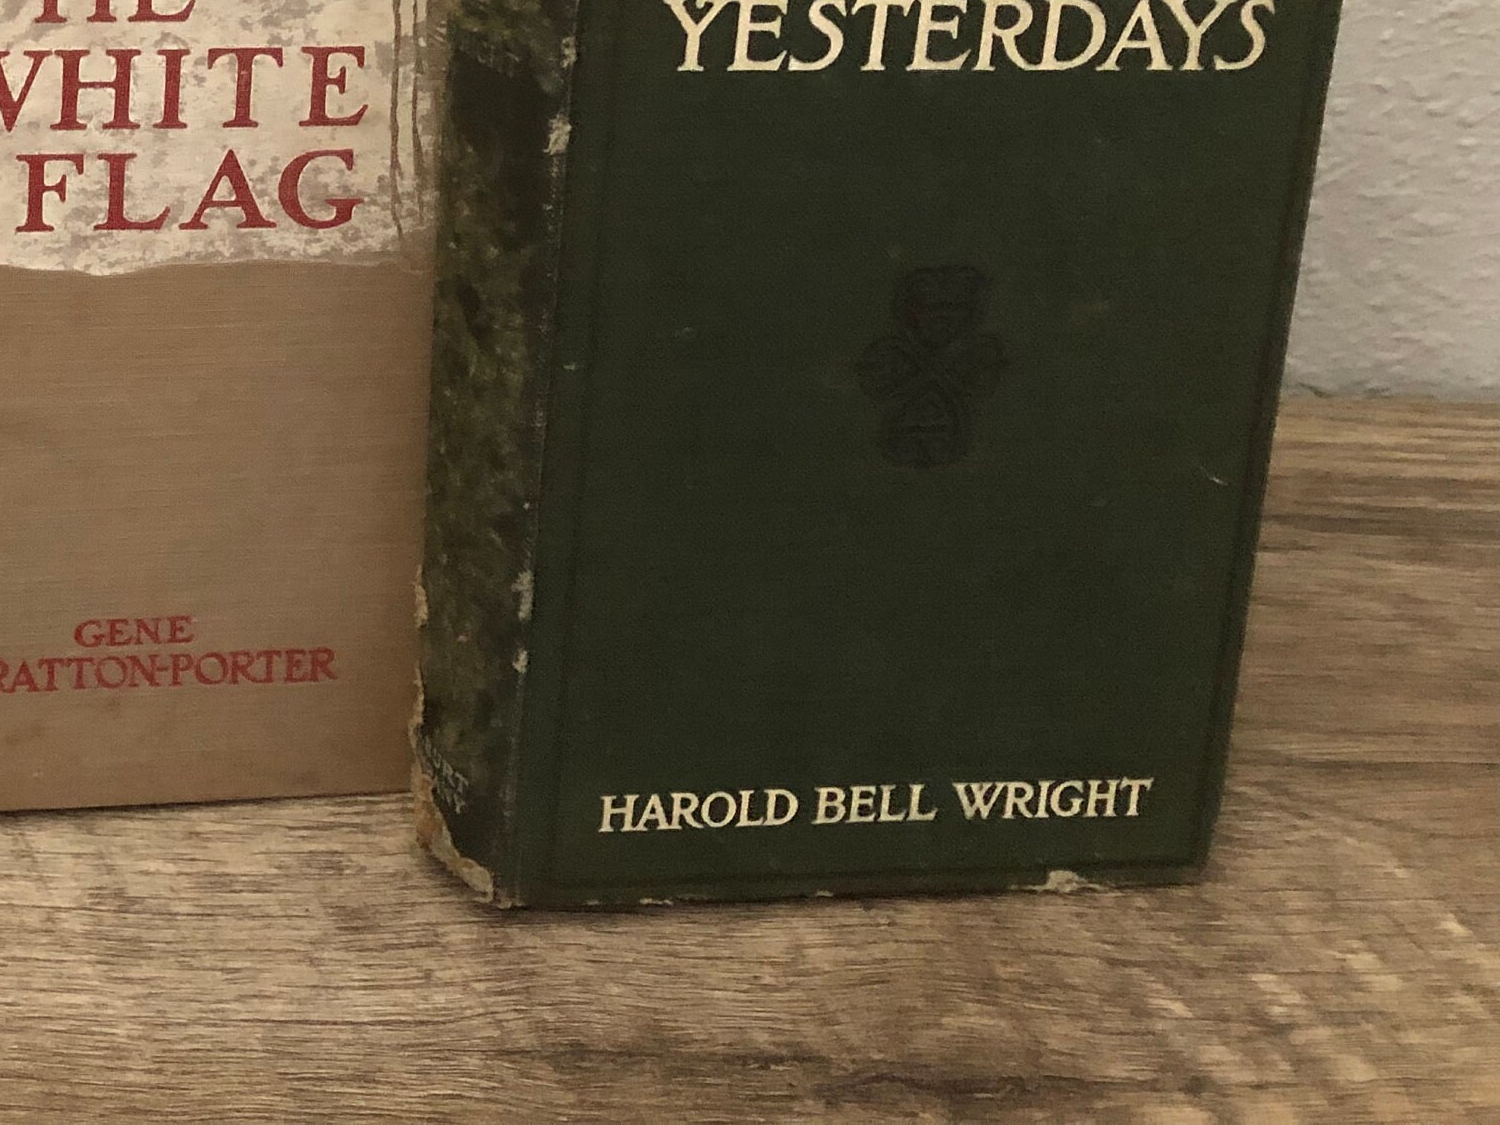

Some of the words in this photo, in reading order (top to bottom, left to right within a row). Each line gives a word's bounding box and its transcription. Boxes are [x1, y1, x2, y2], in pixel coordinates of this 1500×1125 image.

[15, 148, 364, 233] FLAG
[73, 615, 195, 649] GENE
[598, 788, 799, 833] HAROLD
[811, 783, 938, 826] BELL
[951, 776, 1155, 820] WRIGHT
